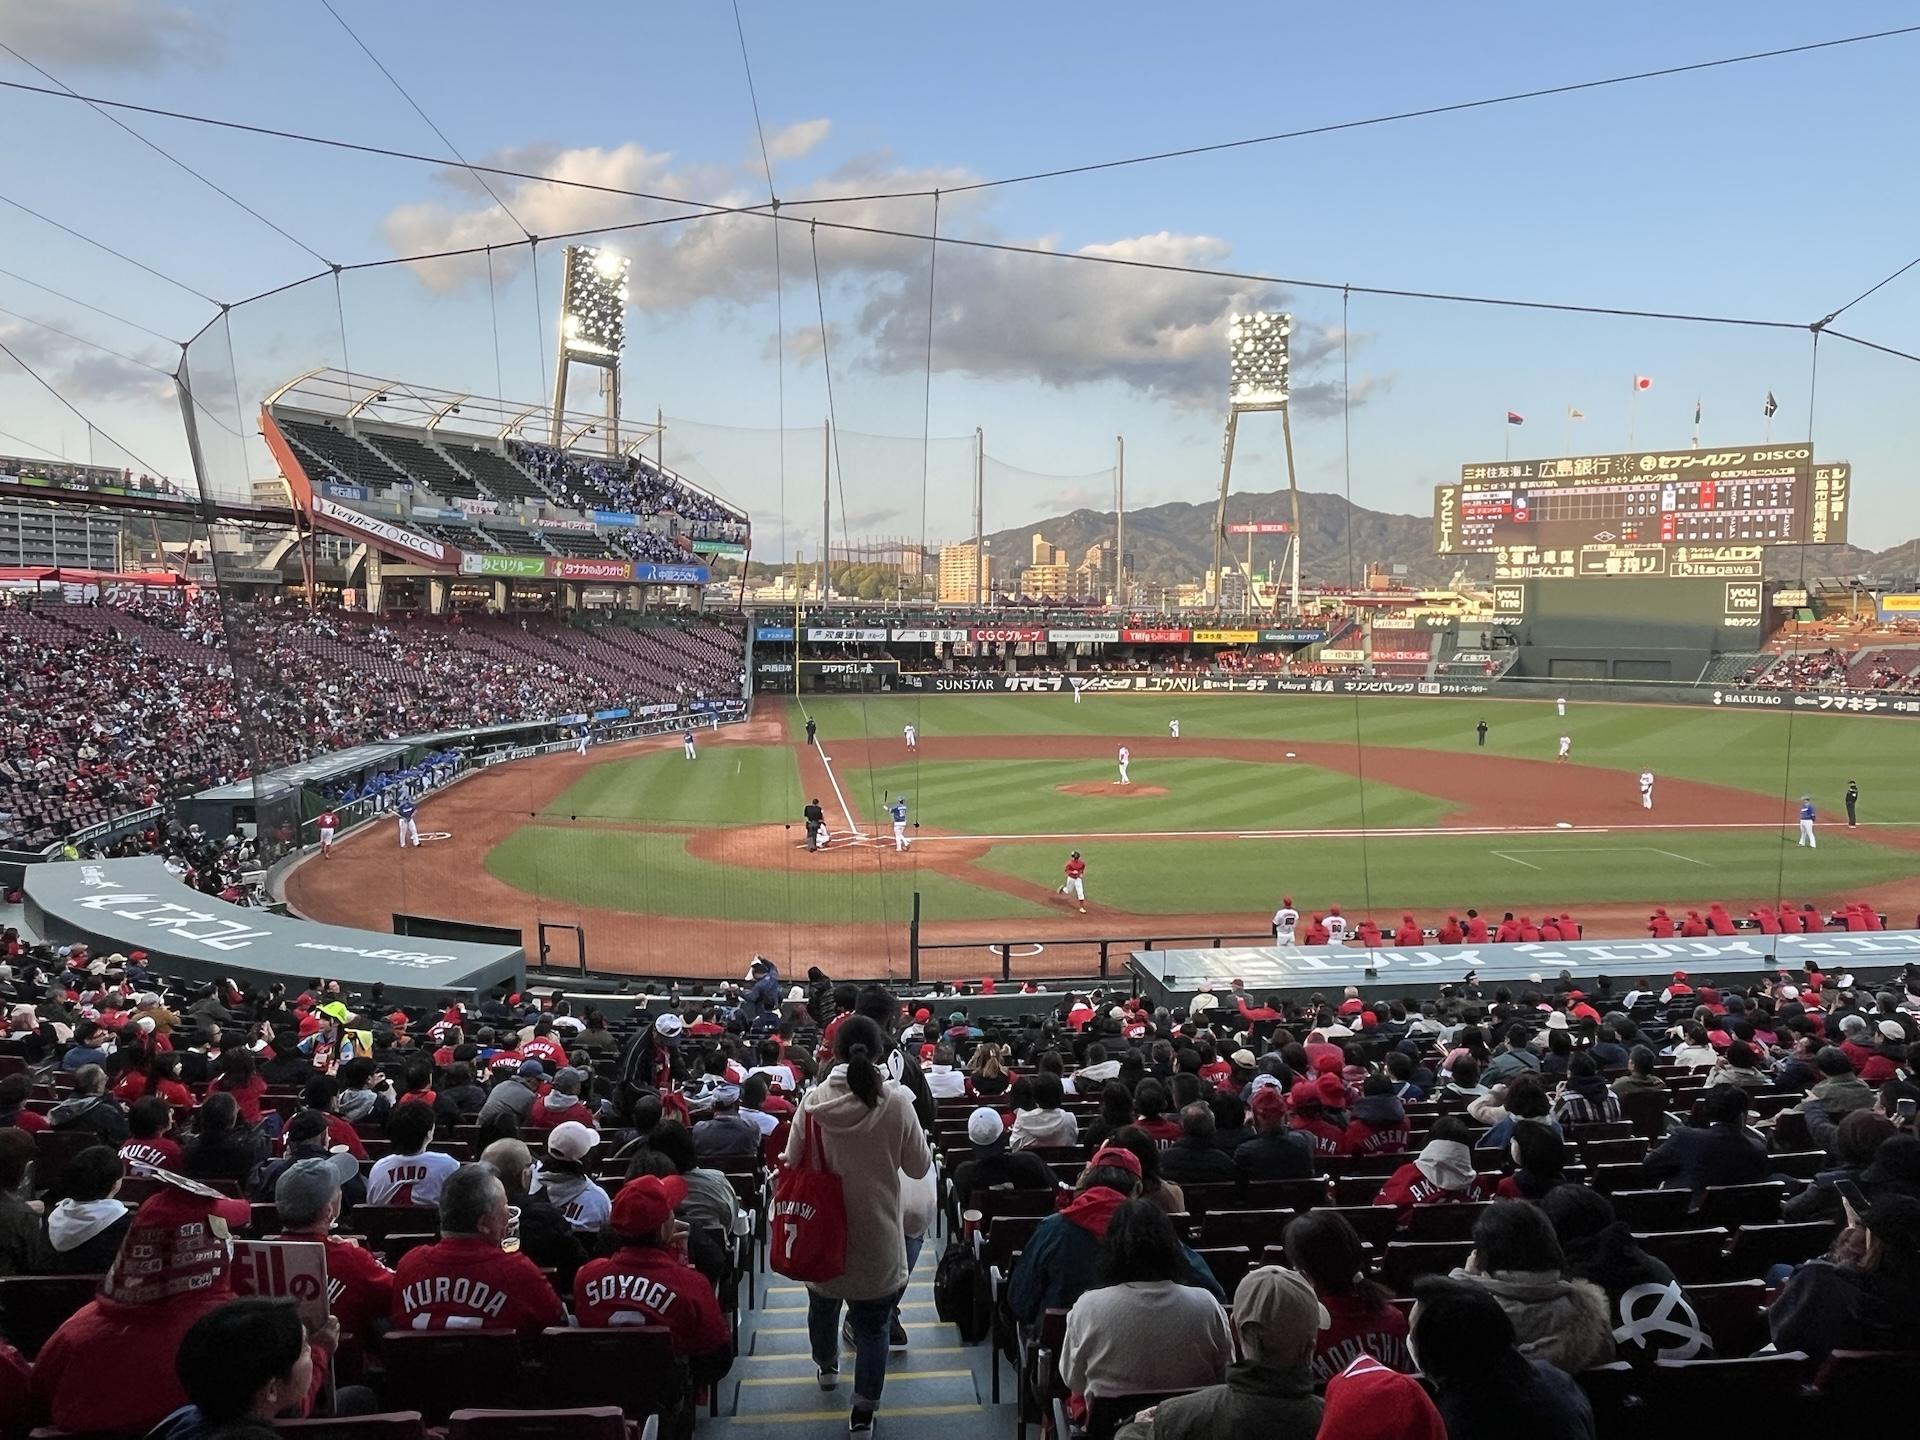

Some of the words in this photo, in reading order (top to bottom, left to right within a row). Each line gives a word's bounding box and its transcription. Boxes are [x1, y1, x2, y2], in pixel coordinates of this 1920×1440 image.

[1753, 449, 1810, 462] DISCO
[1463, 465, 1533, 480] 三井住友海上
[1538, 458, 1611, 478] 広島銀行
[1628, 494, 1634, 502] 0
[1639, 493, 1645, 502] 0
[1650, 493, 1656, 501] 0
[1627, 507, 1633, 515] 0
[1639, 506, 1645, 515] 0
[1650, 505, 1656, 514] 0
[400, 533, 430, 551] RCC
[1714, 546, 1763, 561] ムロオ
[483, 558, 544, 572] みどりグループ
[564, 563, 624, 577] タナカのふりかけ
[1497, 590, 1519, 601] you
[1730, 588, 1757, 601] you
[1501, 600, 1520, 608] me
[1734, 599, 1758, 608] me
[919, 630, 963, 640] 中国電力
[976, 631, 1040, 641] CGCグループ
[758, 664, 792, 673] JR西日本
[936, 680, 994, 690] SUNSTAR
[1005, 677, 1062, 691] クマヒラ
[1151, 677, 1200, 691] ユウベル
[1278, 681, 1307, 691] Fukuya
[1310, 680, 1334, 692] 福屋
[1344, 682, 1414, 692] キリンビバレッジ
[1725, 695, 1781, 704] SAKURAO
[1819, 696, 1888, 711] フマキラー
[387, 1166, 427, 1183] YANO
[784, 1223, 797, 1259] 7
[402, 1277, 508, 1319] KURODA
[585, 1275, 677, 1314] SOYOGI
